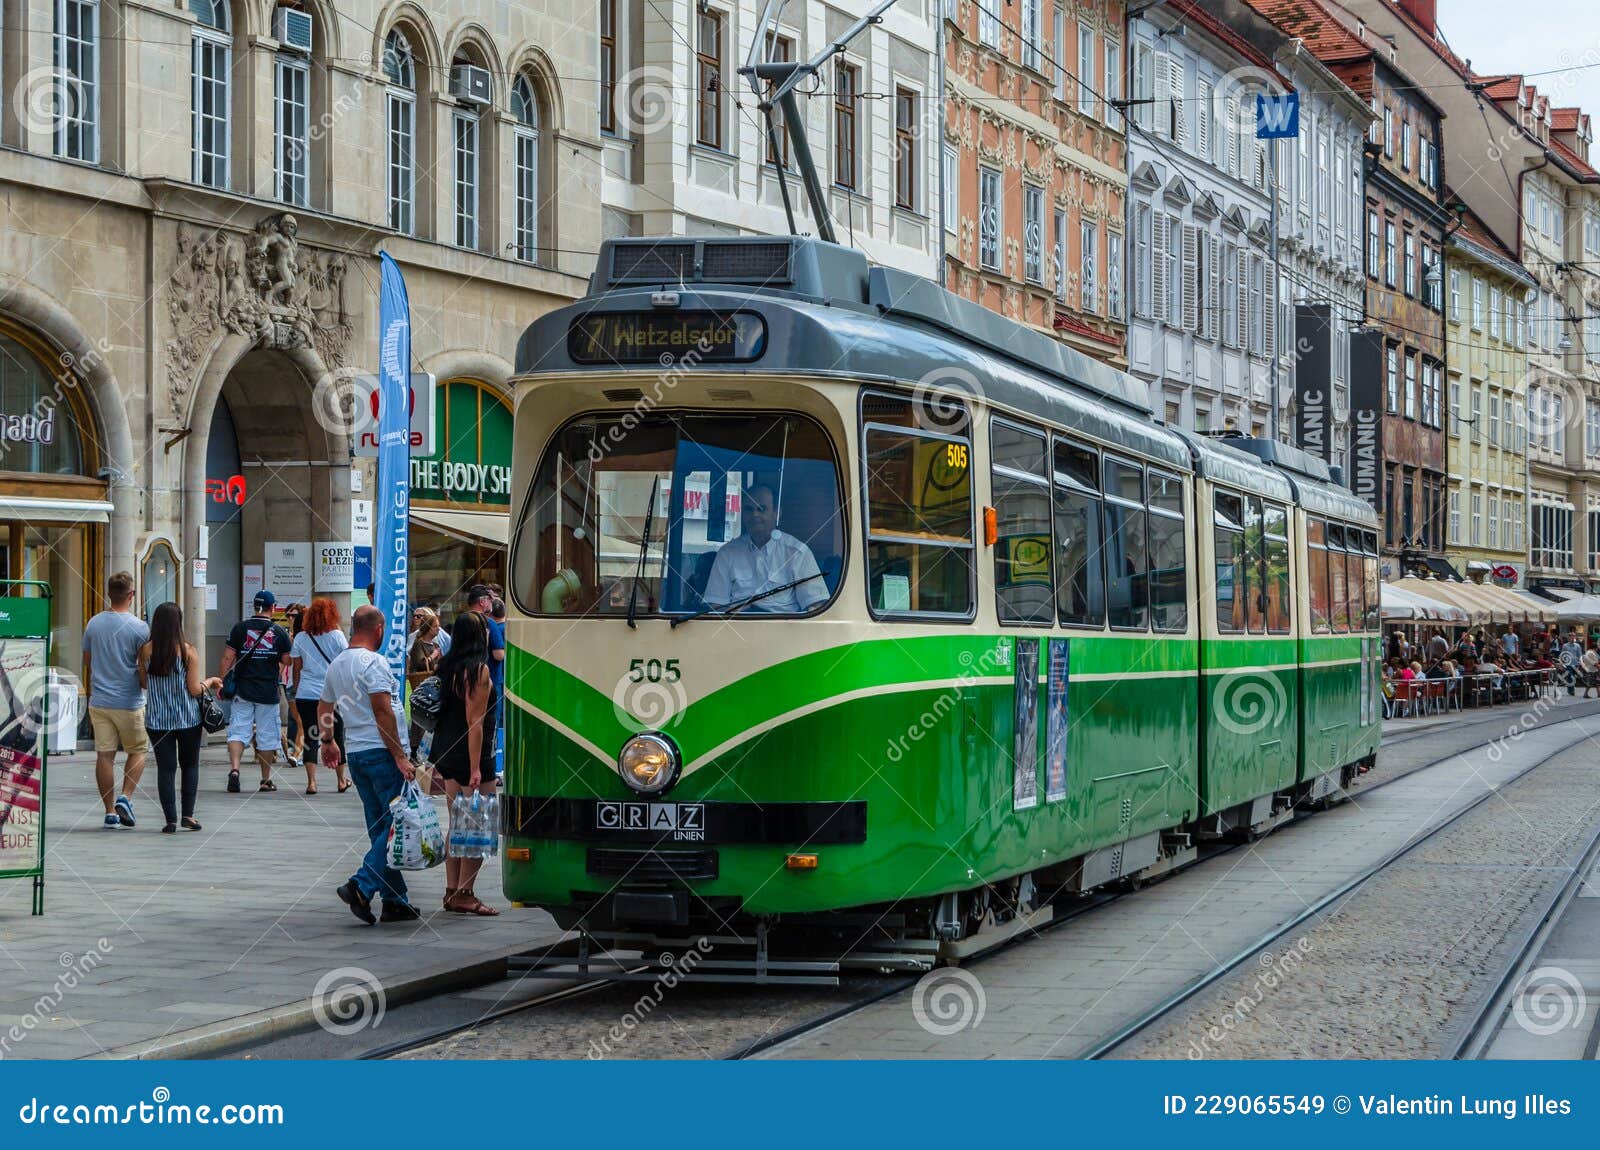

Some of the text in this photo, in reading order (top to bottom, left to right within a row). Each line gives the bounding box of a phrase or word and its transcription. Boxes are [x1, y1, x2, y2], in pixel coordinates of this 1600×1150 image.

[1261, 102, 1294, 132] W
[586, 318, 606, 353] 7
[362, 432, 423, 447] rua
[947, 444, 967, 468] 505
[410, 459, 512, 494] THE BODY SH
[629, 658, 681, 683] 505
[597, 802, 704, 830] GRAZ
[674, 831, 704, 841] LINIEN
